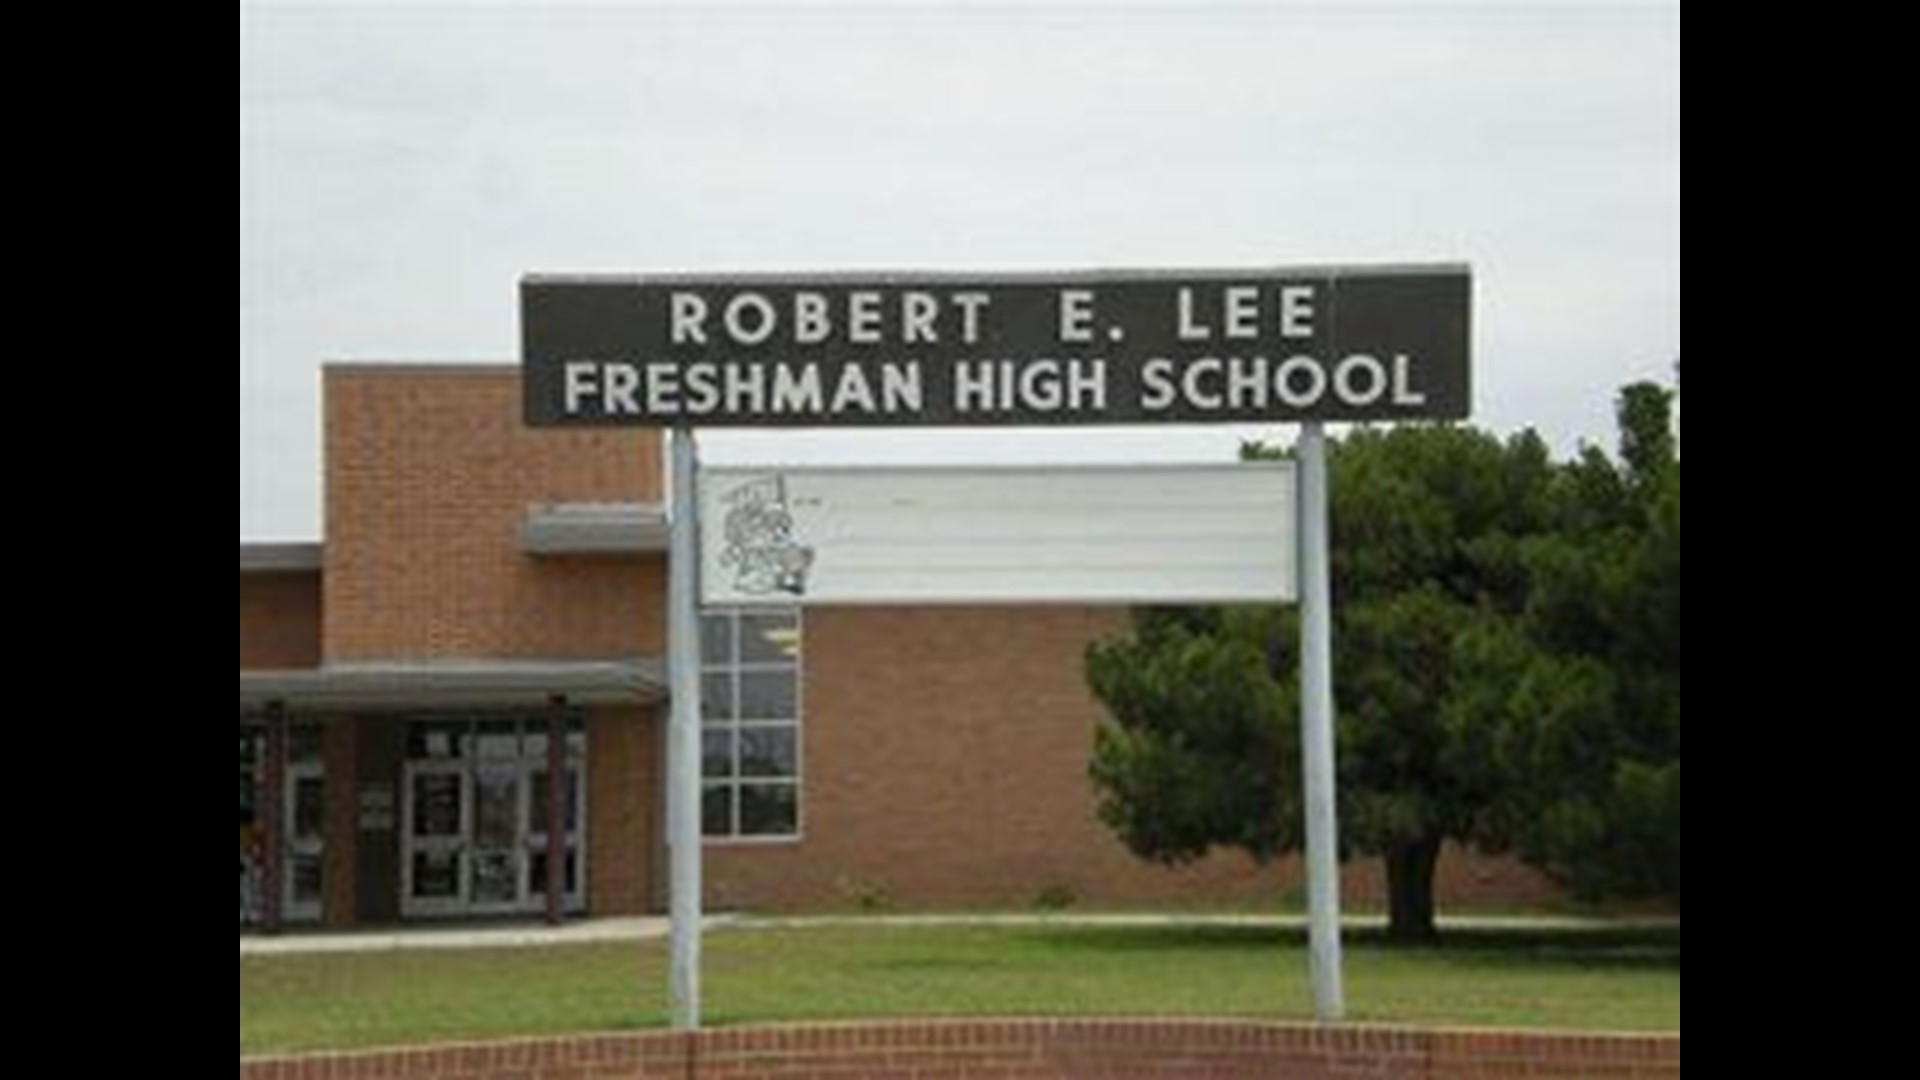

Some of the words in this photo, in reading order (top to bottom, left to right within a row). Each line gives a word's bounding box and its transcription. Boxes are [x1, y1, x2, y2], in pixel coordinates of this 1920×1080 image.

[671, 291, 990, 344] ROBERT
[1060, 290, 1124, 341] E.
[1178, 286, 1316, 339] LEE
[564, 361, 922, 413] FRESHMAN
[955, 359, 1107, 411] HIGH
[1141, 354, 1427, 409] SCHOOL
